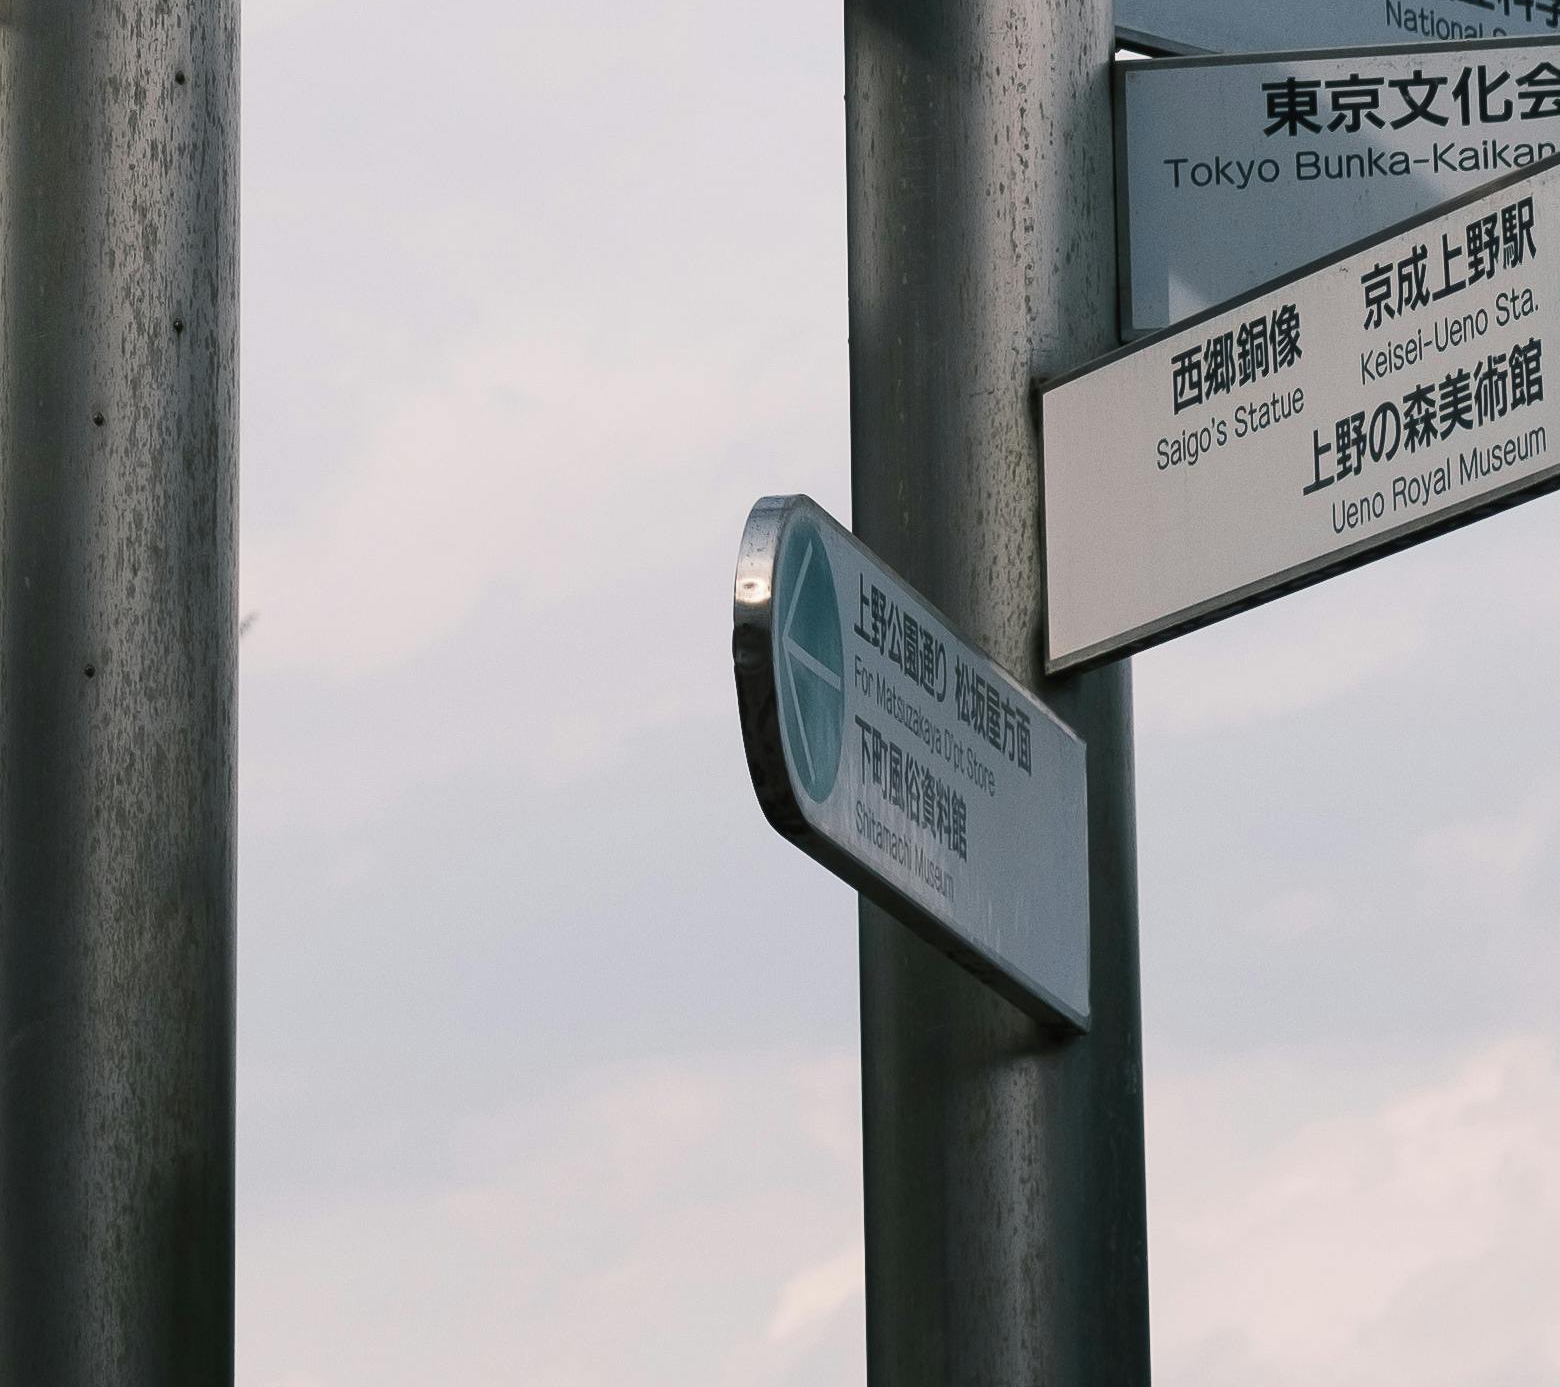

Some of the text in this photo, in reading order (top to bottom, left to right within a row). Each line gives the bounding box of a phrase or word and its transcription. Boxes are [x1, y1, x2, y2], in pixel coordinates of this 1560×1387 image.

[1164, 137, 1556, 190] Tokyo Bunka-Kaikan
[1360, 196, 1537, 331] 京成上野駅
[1171, 303, 1303, 415] 西郷銅像
[1360, 288, 1539, 385] Keisei-Ueno Sta.
[1157, 387, 1305, 470] Saigo's Statue
[1303, 337, 1543, 496] 上野の森美術館
[1332, 426, 1547, 533] Ueno Royal Museum
[854, 573, 1032, 777] 上野公園通り 松坂屋方面
[854, 654, 873, 698] For
[876, 674, 941, 757] Matsuzakaya
[967, 747, 996, 798] Store
[854, 714, 967, 863] 下町風俗資料館
[855, 799, 954, 901] Shitamachi Museum
